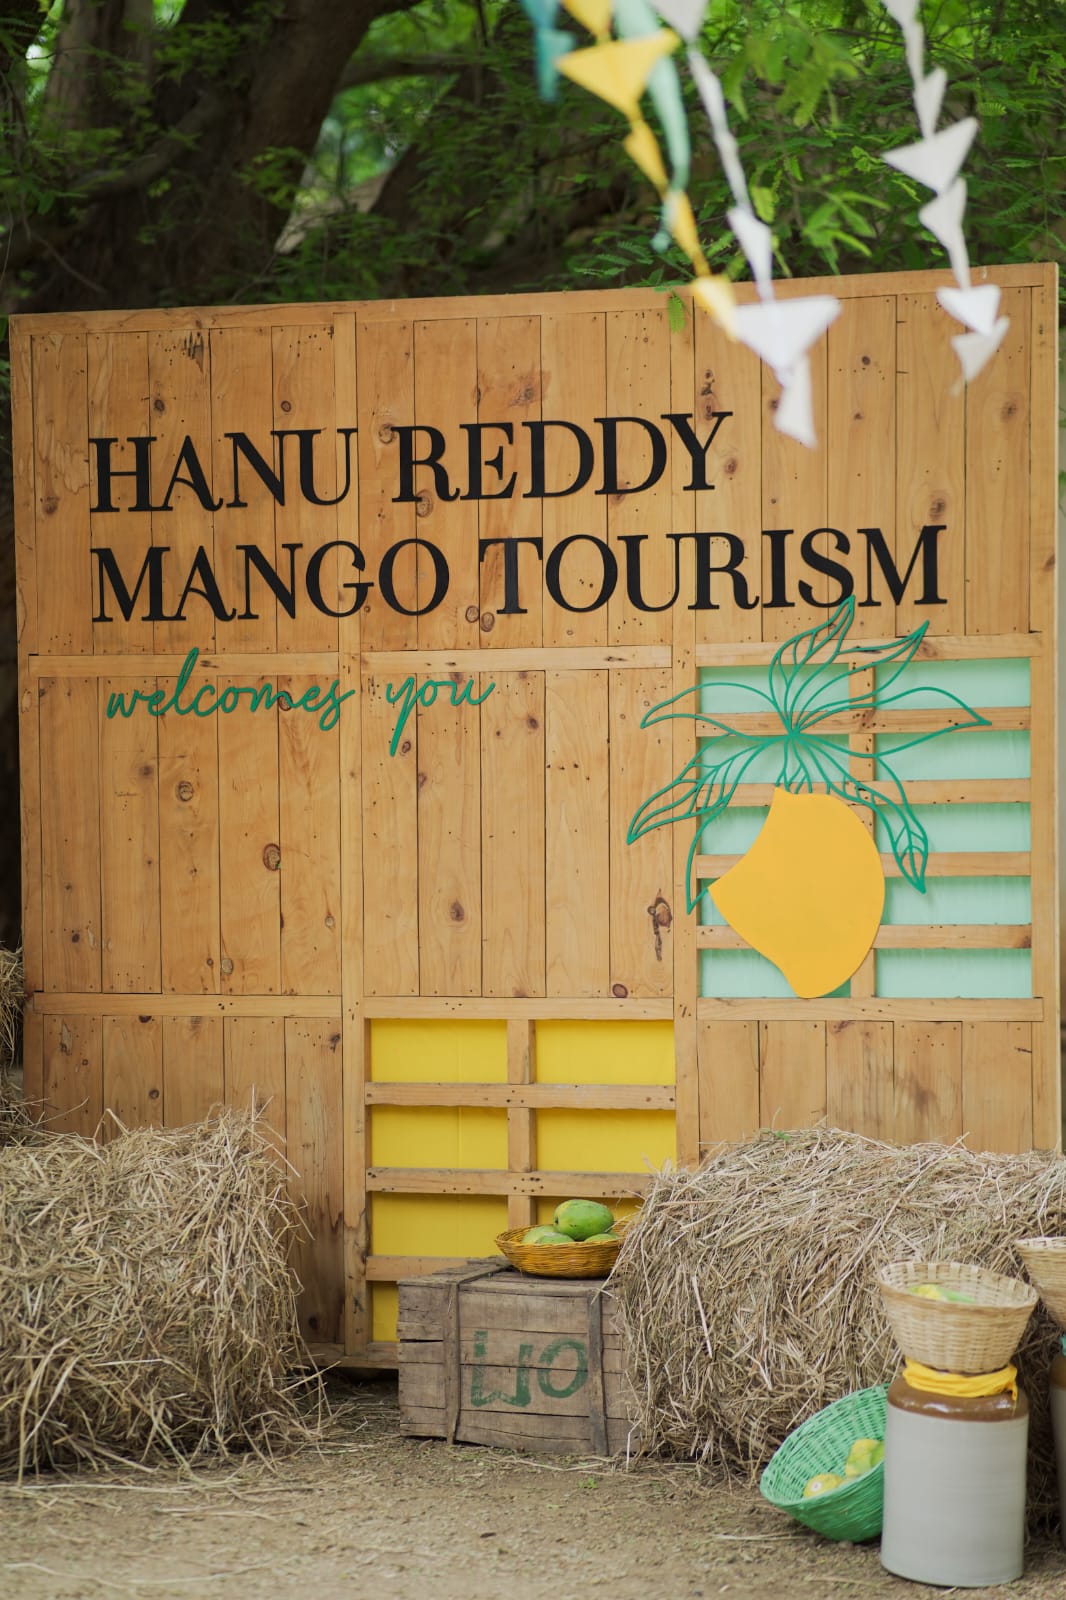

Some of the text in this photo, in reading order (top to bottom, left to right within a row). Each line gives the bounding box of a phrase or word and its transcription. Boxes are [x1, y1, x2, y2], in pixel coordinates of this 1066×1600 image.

[88, 411, 733, 513] HANU REDDY
[90, 525, 947, 622] MANGO TOURISM
[107, 647, 496, 757] welcomes you
